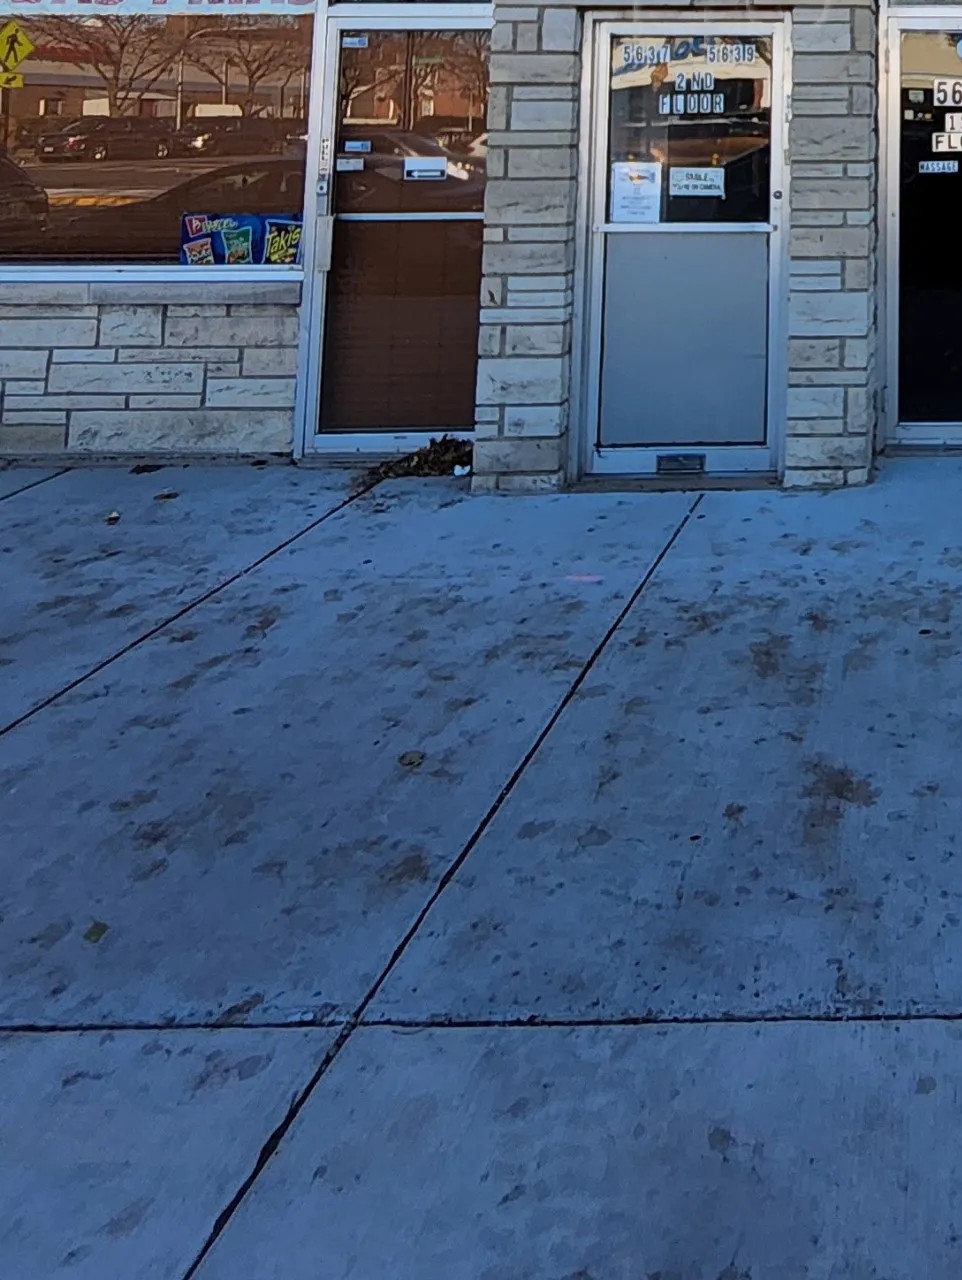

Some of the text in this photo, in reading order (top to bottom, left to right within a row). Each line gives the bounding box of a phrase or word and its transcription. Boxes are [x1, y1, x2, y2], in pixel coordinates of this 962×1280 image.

[623, 45, 669, 62] 5637
[708, 46, 755, 62] 5639
[661, 96, 725, 113] FLOOR
